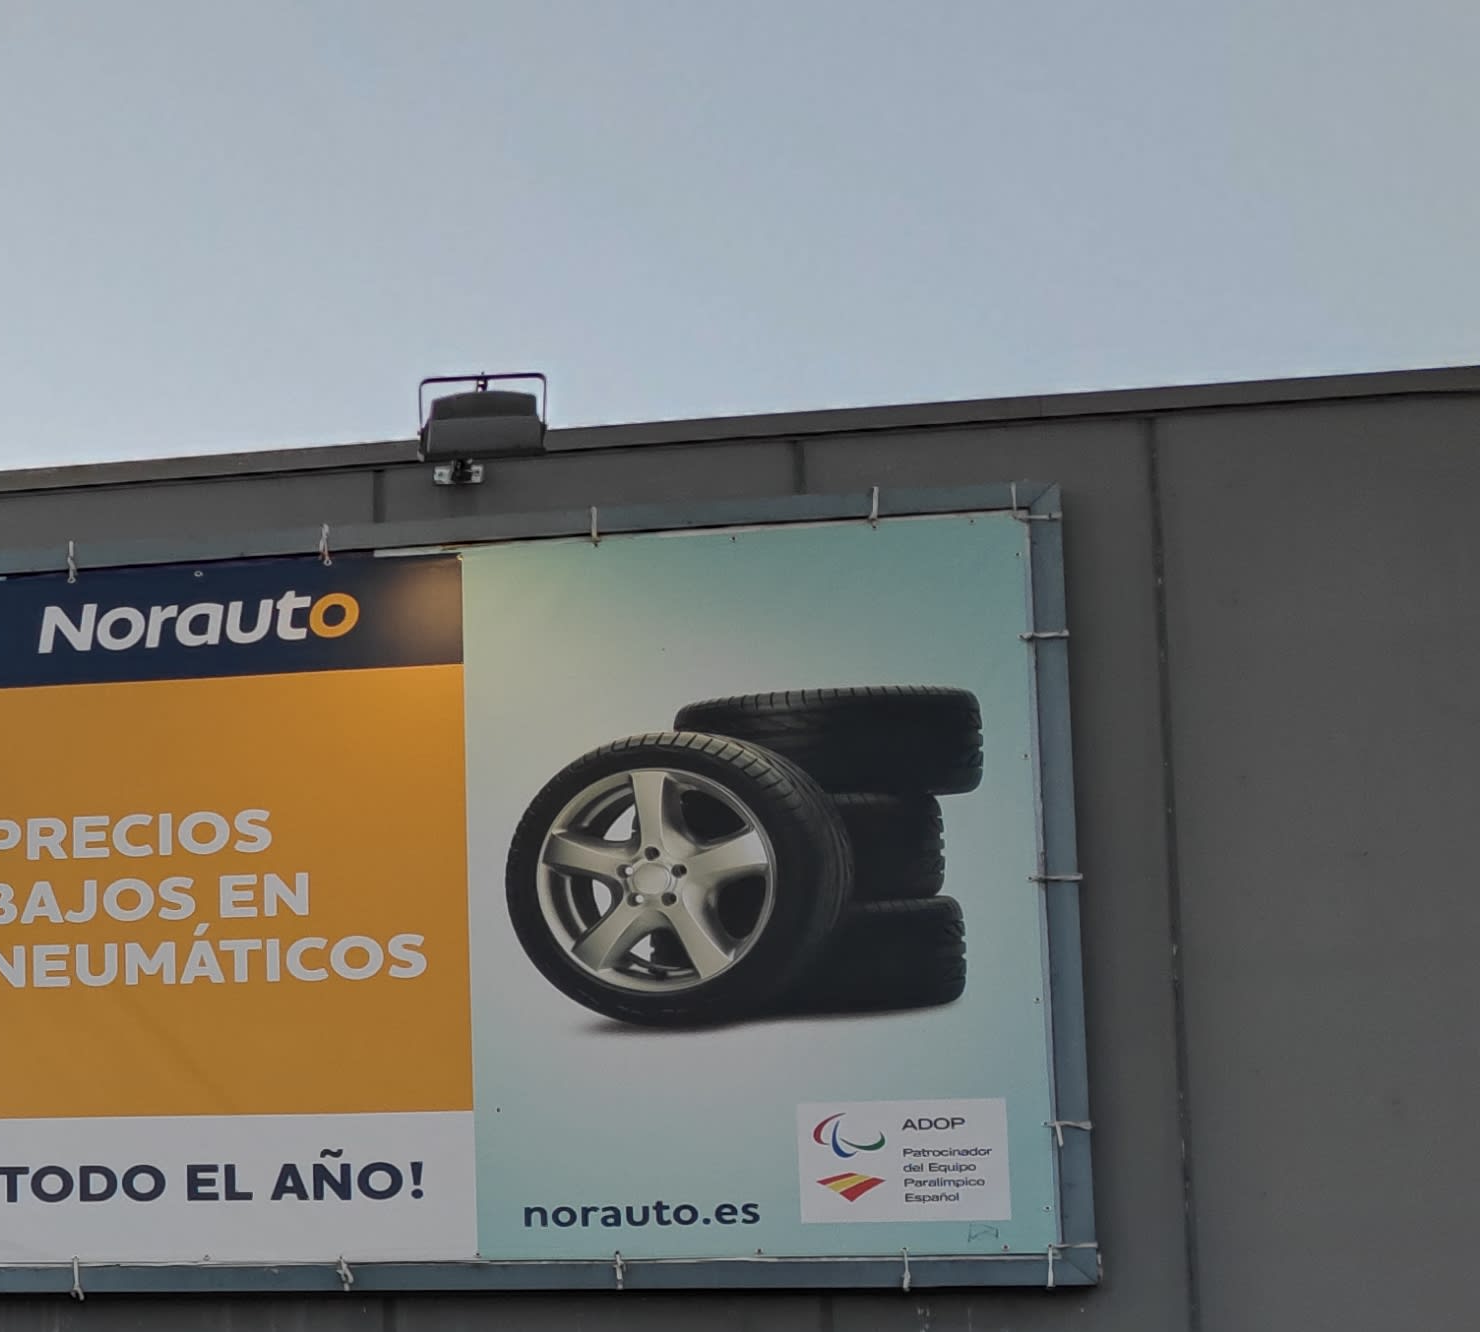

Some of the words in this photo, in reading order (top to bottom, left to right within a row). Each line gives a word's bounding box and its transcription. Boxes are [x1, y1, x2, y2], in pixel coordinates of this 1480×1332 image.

[38, 590, 359, 654] Norauto
[219, 872, 309, 918] EN
[902, 1117, 965, 1131] ADOP
[903, 1147, 992, 1158] Patrocinador
[186, 1164, 253, 1202] EL
[270, 1148, 424, 1201] AÑO!
[903, 1163, 923, 1173] del
[928, 1163, 976, 1174] Equipo
[904, 1191, 959, 1203] Español
[523, 1199, 761, 1230] norauto.es
